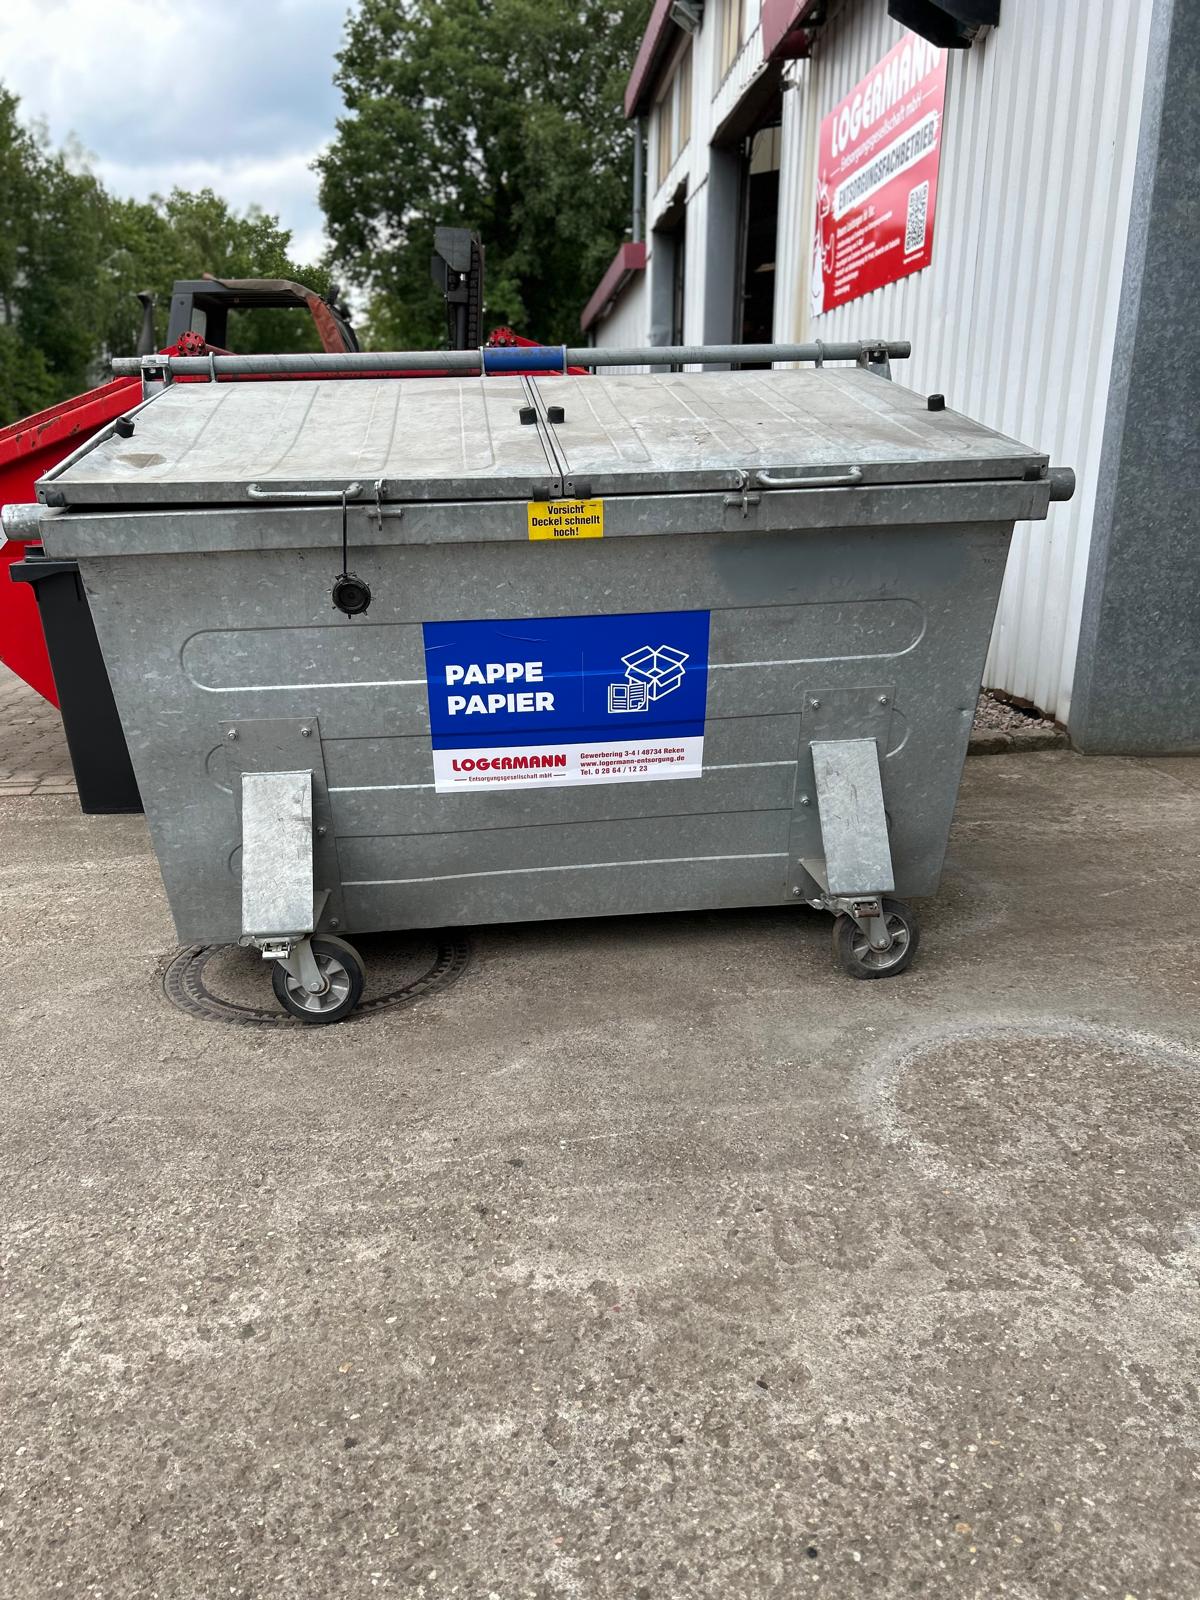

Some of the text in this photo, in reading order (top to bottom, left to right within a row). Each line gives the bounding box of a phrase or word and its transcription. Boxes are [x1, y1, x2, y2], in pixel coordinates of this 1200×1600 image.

[831, 34, 941, 157] LOGERMANN
[838, 121, 935, 211] ENTSORGUNGSFACHBETRIEB
[547, 505, 585, 515] Vorsicht
[531, 515, 600, 526] Deckel schnellt
[553, 527, 579, 537] hoch!
[445, 661, 544, 686] PAPPE
[447, 691, 555, 716] PAPIER
[580, 751, 623, 759] Gewerbering
[580, 755, 685, 767] www.logermann-entsorgung.de
[452, 754, 567, 772] LOGERMANN
[468, 774, 538, 782] Entsorgungsgesellschaft
